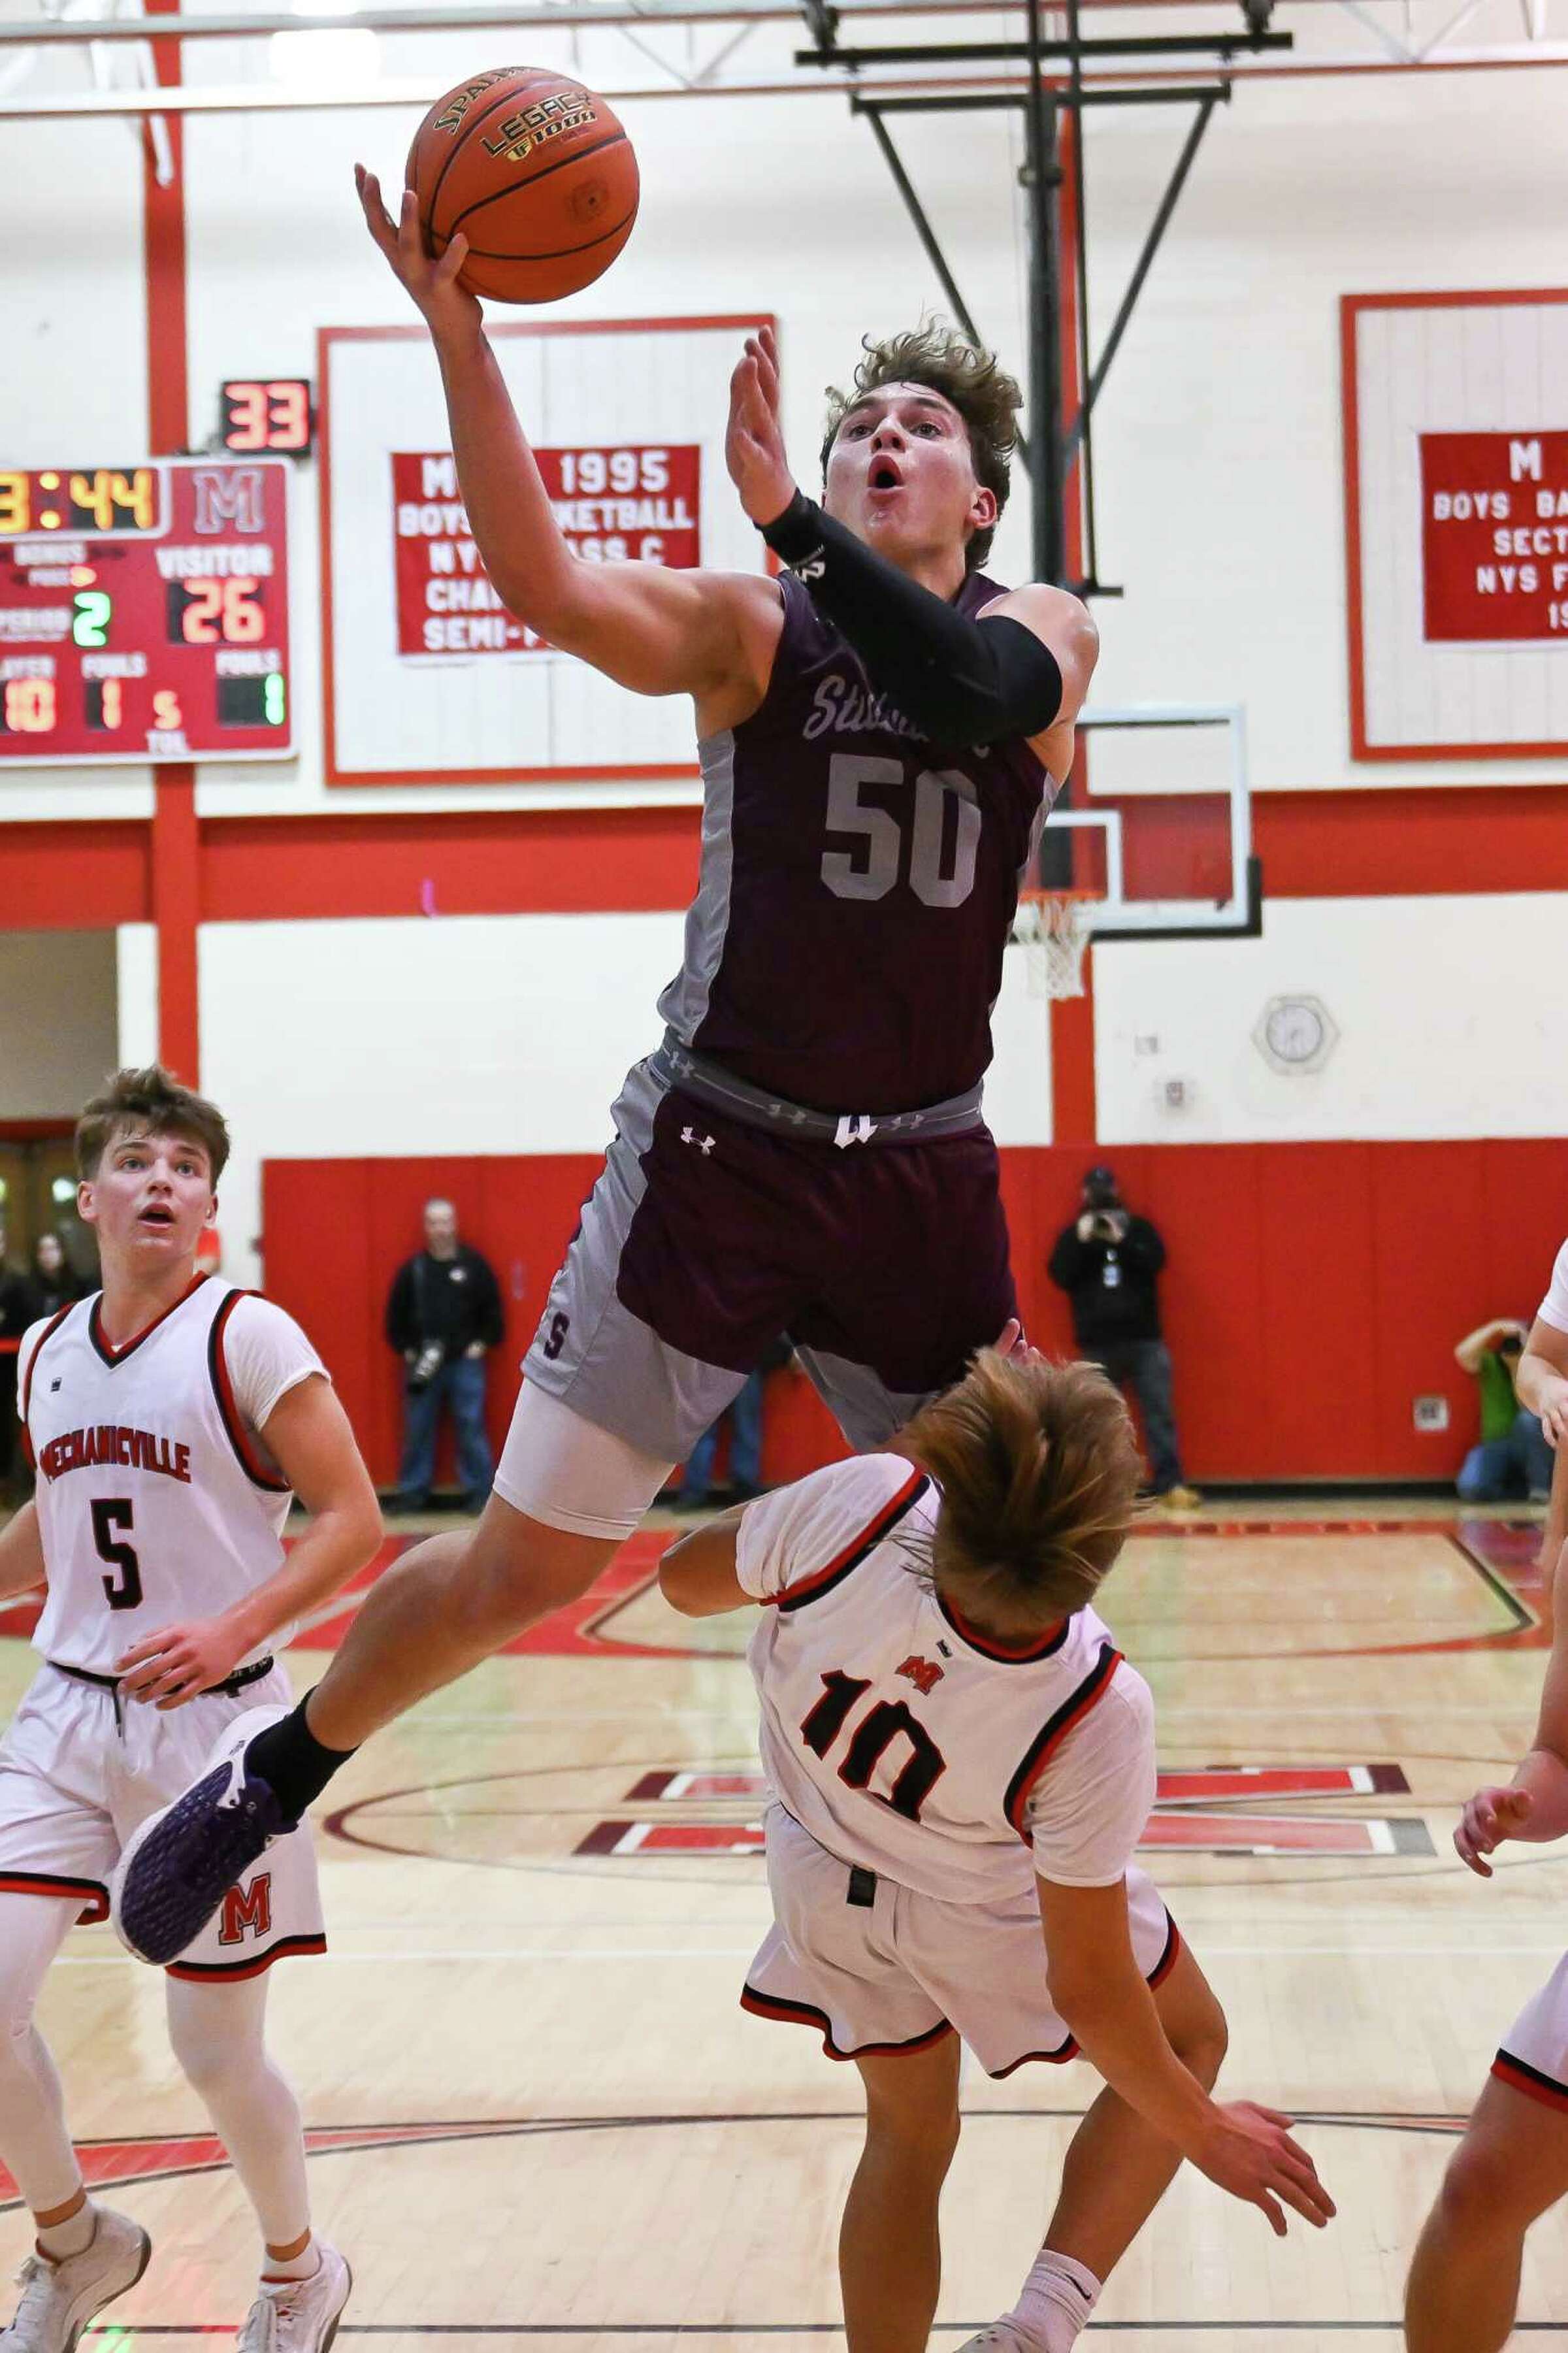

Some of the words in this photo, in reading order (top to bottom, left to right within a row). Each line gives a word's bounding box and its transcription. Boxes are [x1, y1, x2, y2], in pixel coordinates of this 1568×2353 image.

[225, 381, 308, 450] 33
[422, 458, 457, 499] M
[560, 450, 669, 495] 1995
[1509, 439, 1543, 482] M
[193, 467, 265, 533] M
[1433, 492, 1510, 520] BOYS
[1476, 565, 1538, 594] NYS
[73, 591, 110, 647] 2
[182, 578, 265, 644] 26
[5, 678, 56, 732] 10
[103, 679, 122, 729] 1
[265, 674, 284, 725] 1
[821, 753, 982, 908] 50
[544, 1311, 570, 1360] S
[39, 1425, 192, 1485] MECHANICVILLE
[90, 1498, 143, 1610] 5
[800, 1670, 947, 1824] 10
[219, 1873, 270, 1945] M
